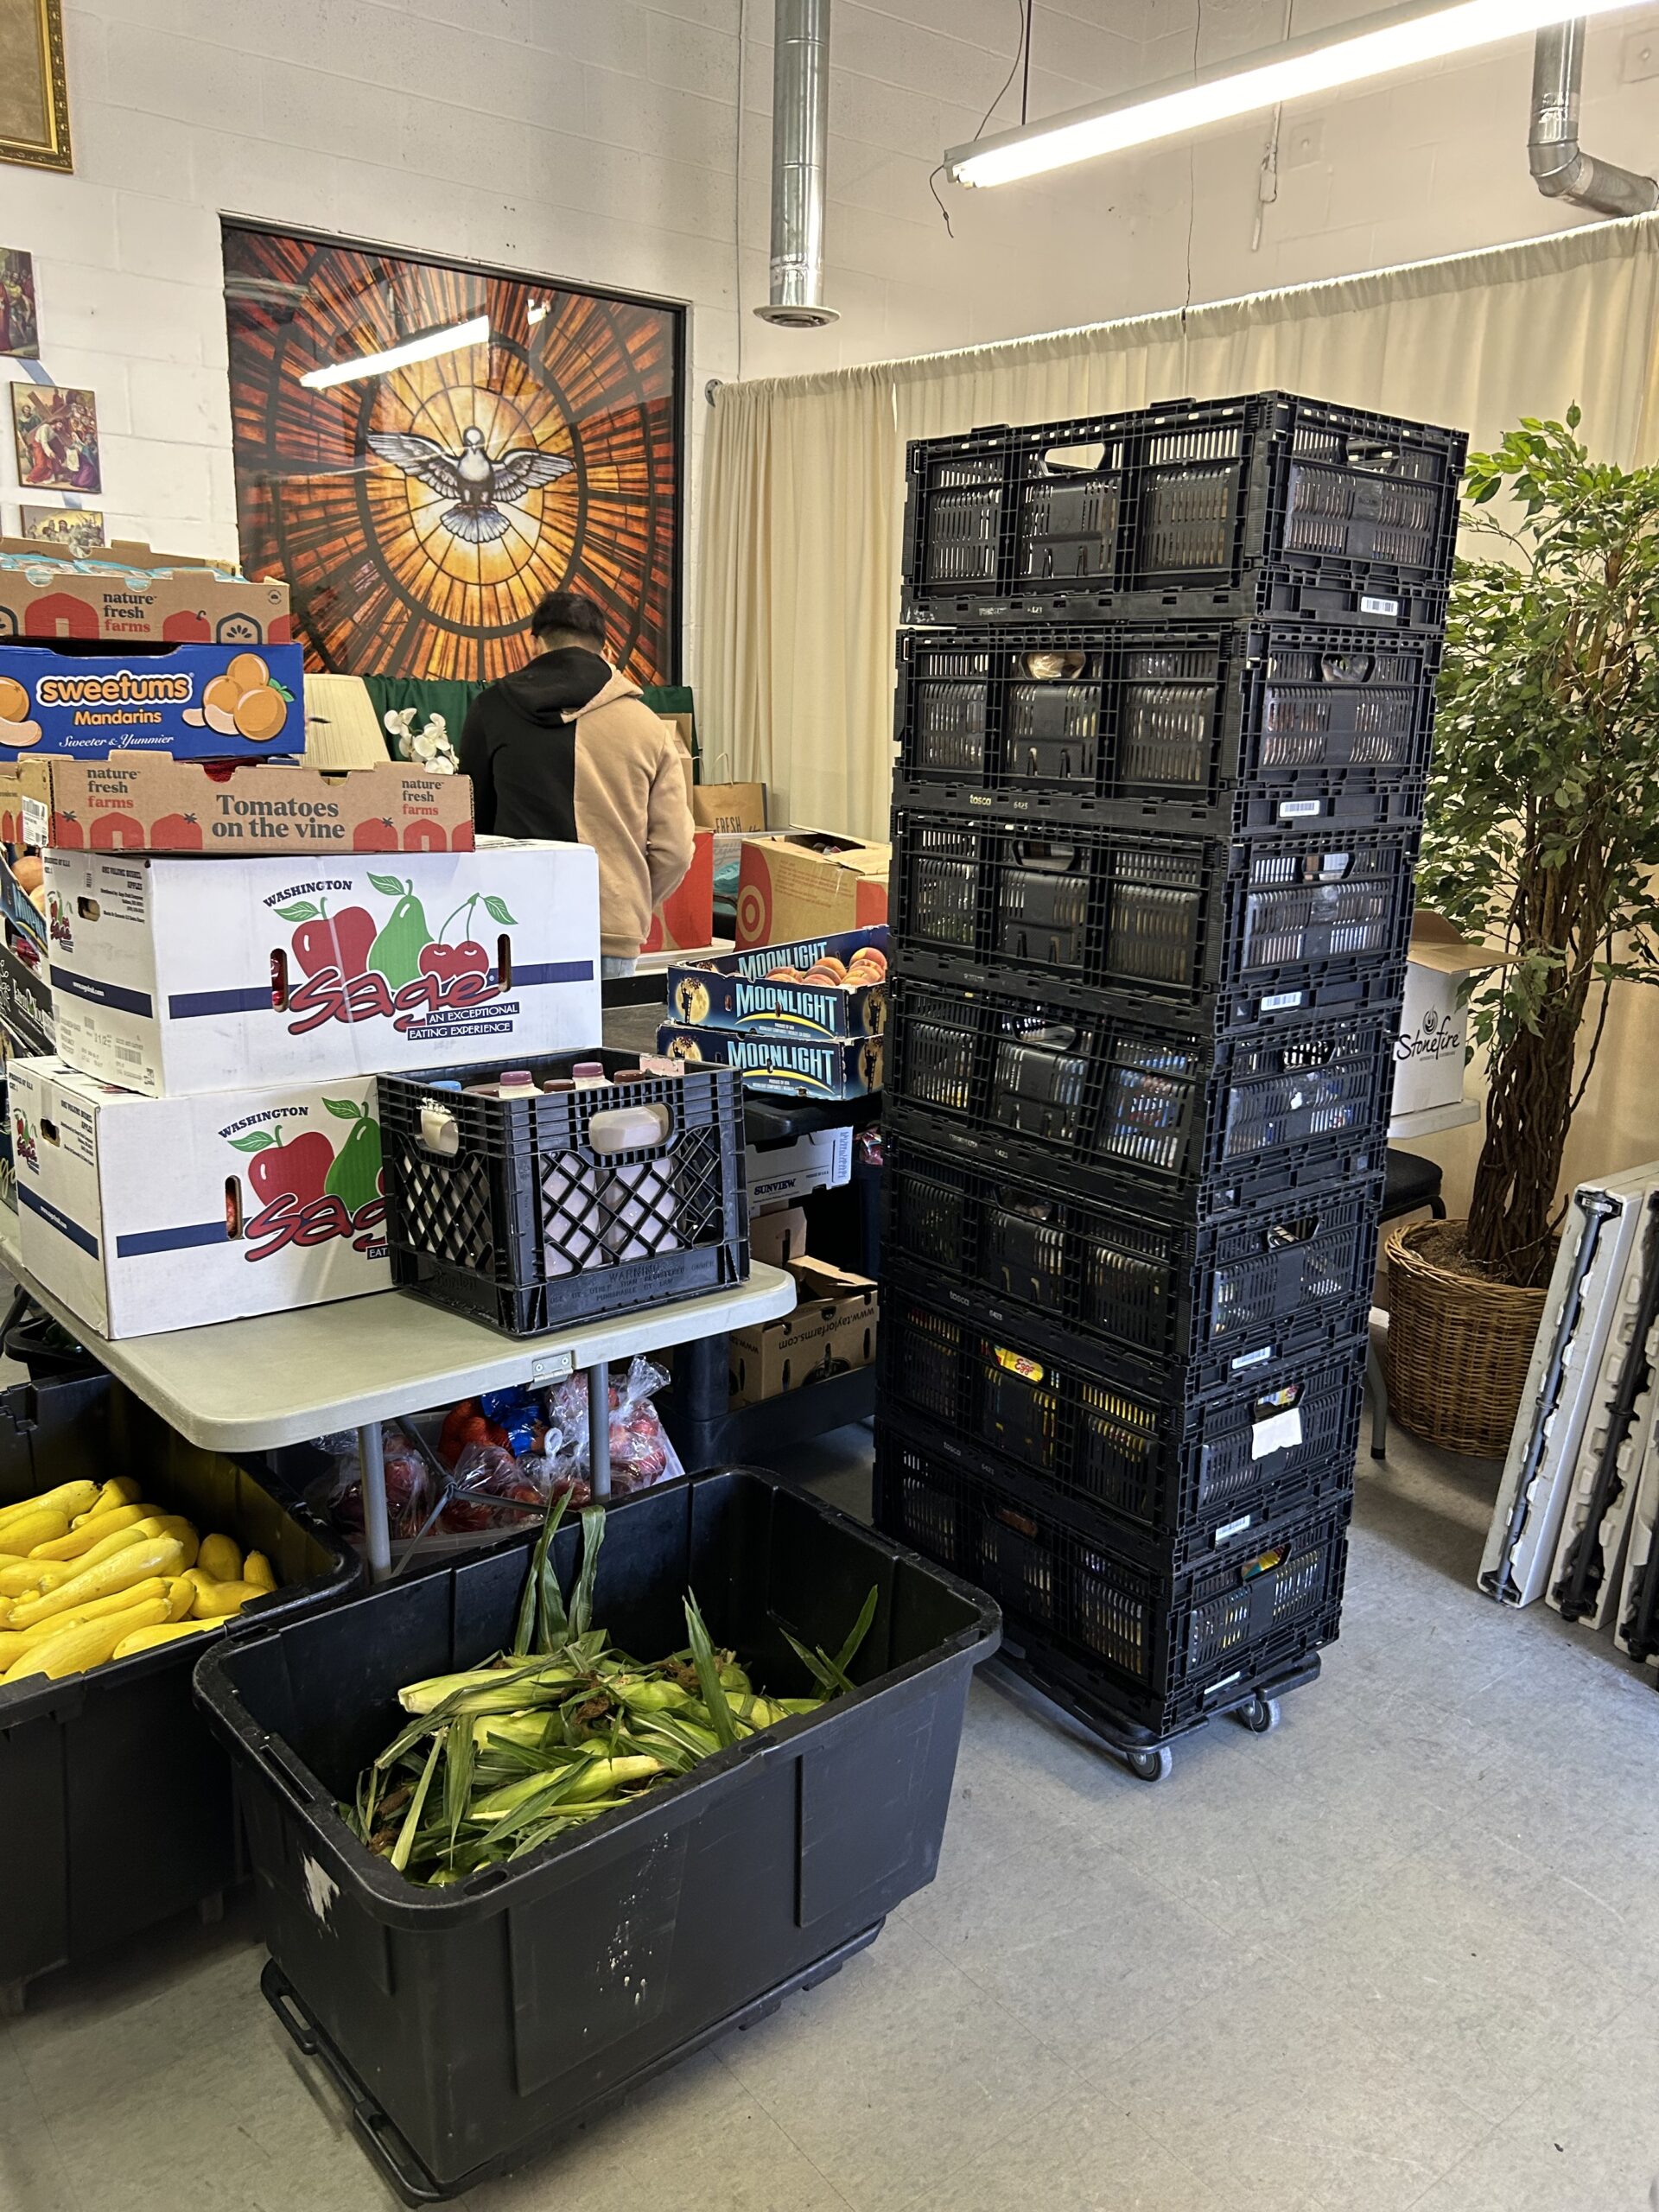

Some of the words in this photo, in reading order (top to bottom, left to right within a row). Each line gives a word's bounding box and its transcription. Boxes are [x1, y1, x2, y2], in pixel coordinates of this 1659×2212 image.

[103, 593, 155, 605] nature
[104, 606, 144, 619] fresh
[104, 620, 151, 632] farms
[40, 671, 190, 704] sweetums
[73, 709, 162, 726] Mandarins
[59, 735, 107, 748] Sweeter
[118, 734, 174, 749] Yummier
[86, 768, 139, 779] nature
[87, 780, 128, 793] fresh
[401, 779, 442, 790] nature
[87, 796, 134, 809] farms
[403, 791, 435, 802] fresh
[969, 794, 991, 805] tosca
[216, 794, 339, 817] Tomatoes
[403, 804, 439, 816] farms
[212, 822, 244, 838] on
[249, 817, 289, 838] the
[294, 817, 346, 839] vine
[715, 817, 741, 832] FRESH
[263, 880, 353, 907] WASHINGTON
[288, 969, 501, 1036] Sage
[736, 983, 837, 1032] MOONLIGHT
[429, 1013, 447, 1024] AN
[448, 1005, 518, 1020] EXCEPTIONAL
[409, 1027, 448, 1039] EATING
[450, 1022, 511, 1036] EXPERIENCE
[1396, 1015, 1460, 1060] Stonefire
[728, 1041, 835, 1085] MOONLIGHT
[218, 1107, 309, 1139] WASHINGTON
[754, 1179, 796, 1195] SUNVIEW
[245, 1193, 387, 1262] Sag
[369, 1248, 388, 1258] EAT
[608, 1262, 660, 1283] WARNING
[779, 1307, 874, 1350] www.taylorfarms.com
